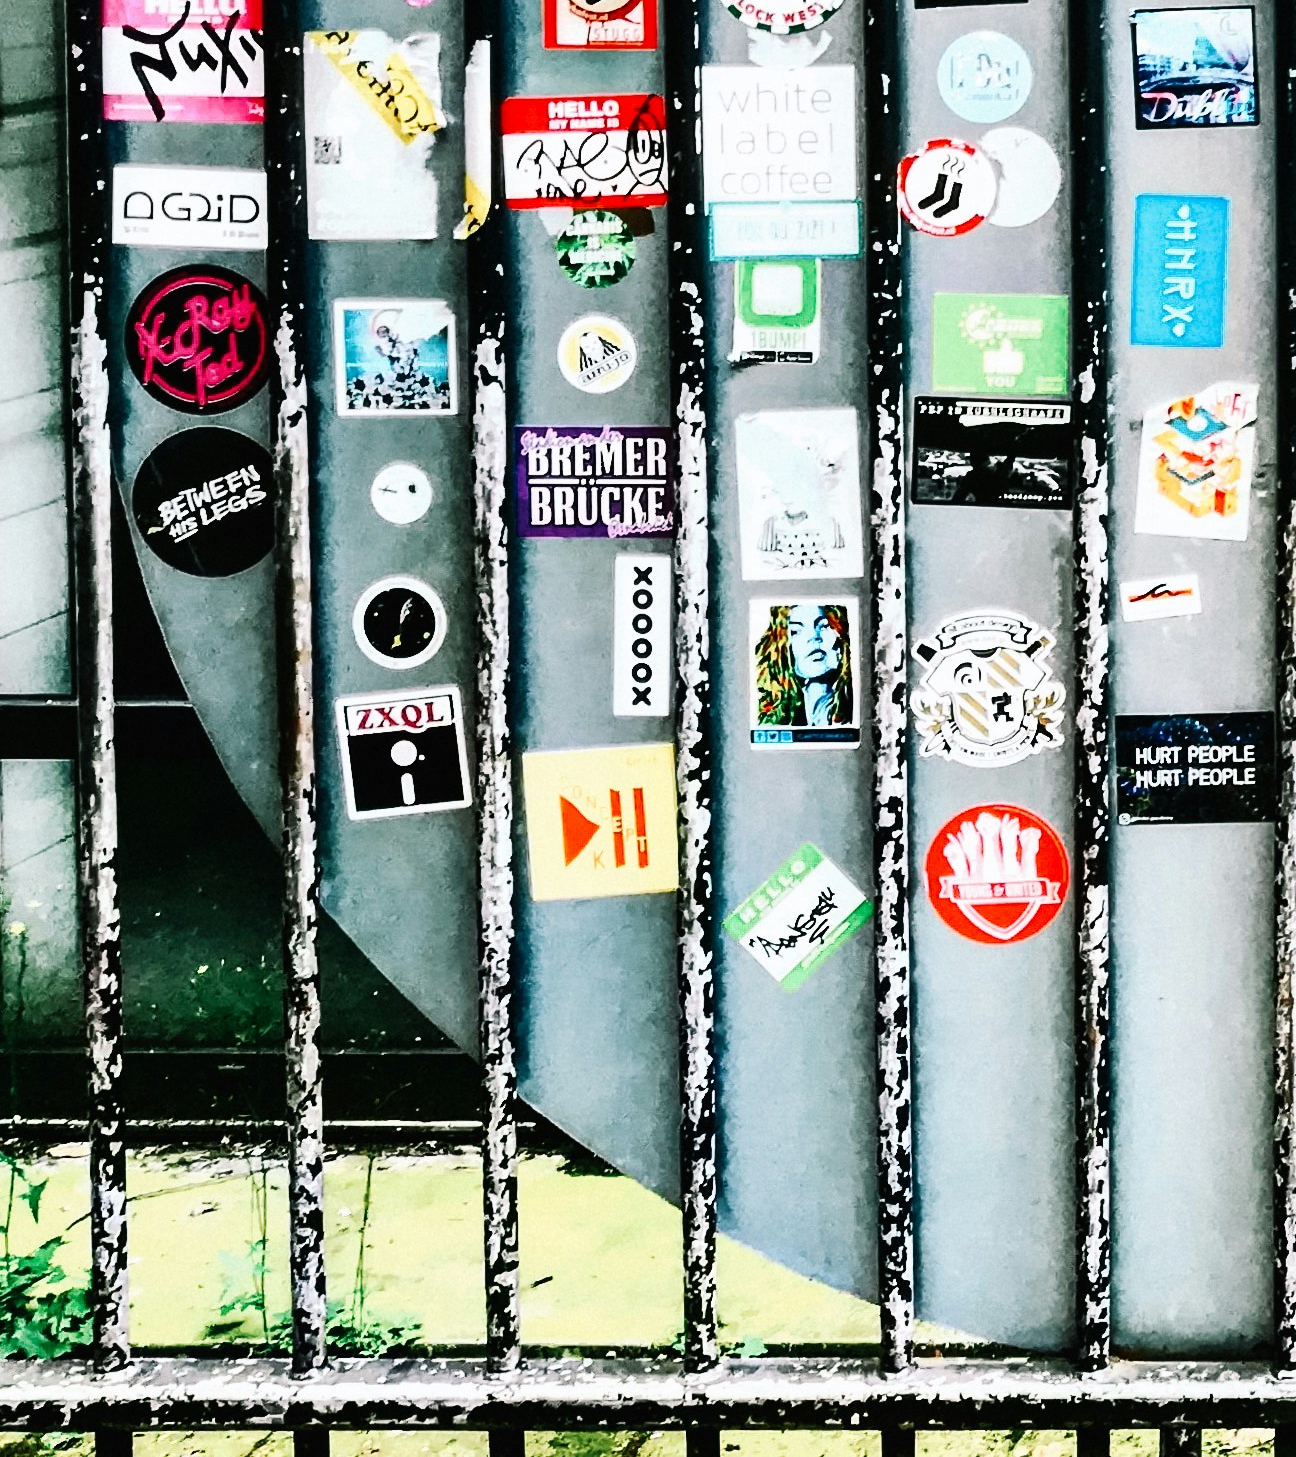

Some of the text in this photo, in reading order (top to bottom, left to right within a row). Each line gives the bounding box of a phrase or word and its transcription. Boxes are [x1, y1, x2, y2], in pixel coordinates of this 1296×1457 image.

[784, 1, 826, 24] WEST
[548, 100, 620, 118] HELLO
[718, 83, 832, 115] white
[549, 117, 620, 130] MY NAME IS
[720, 123, 834, 155] label
[720, 165, 832, 195] coffee
[528, 438, 667, 476] BREMER
[158, 465, 261, 527] BETWEEN
[169, 485, 267, 538] HIS LEGS
[530, 478, 665, 527] BRÜCKE
[355, 701, 445, 731] ZXQL
[1135, 745, 1256, 765] HURT PEOPLE
[1135, 767, 1256, 789] HURT PEOPLE
[739, 860, 807, 924] HELLO
